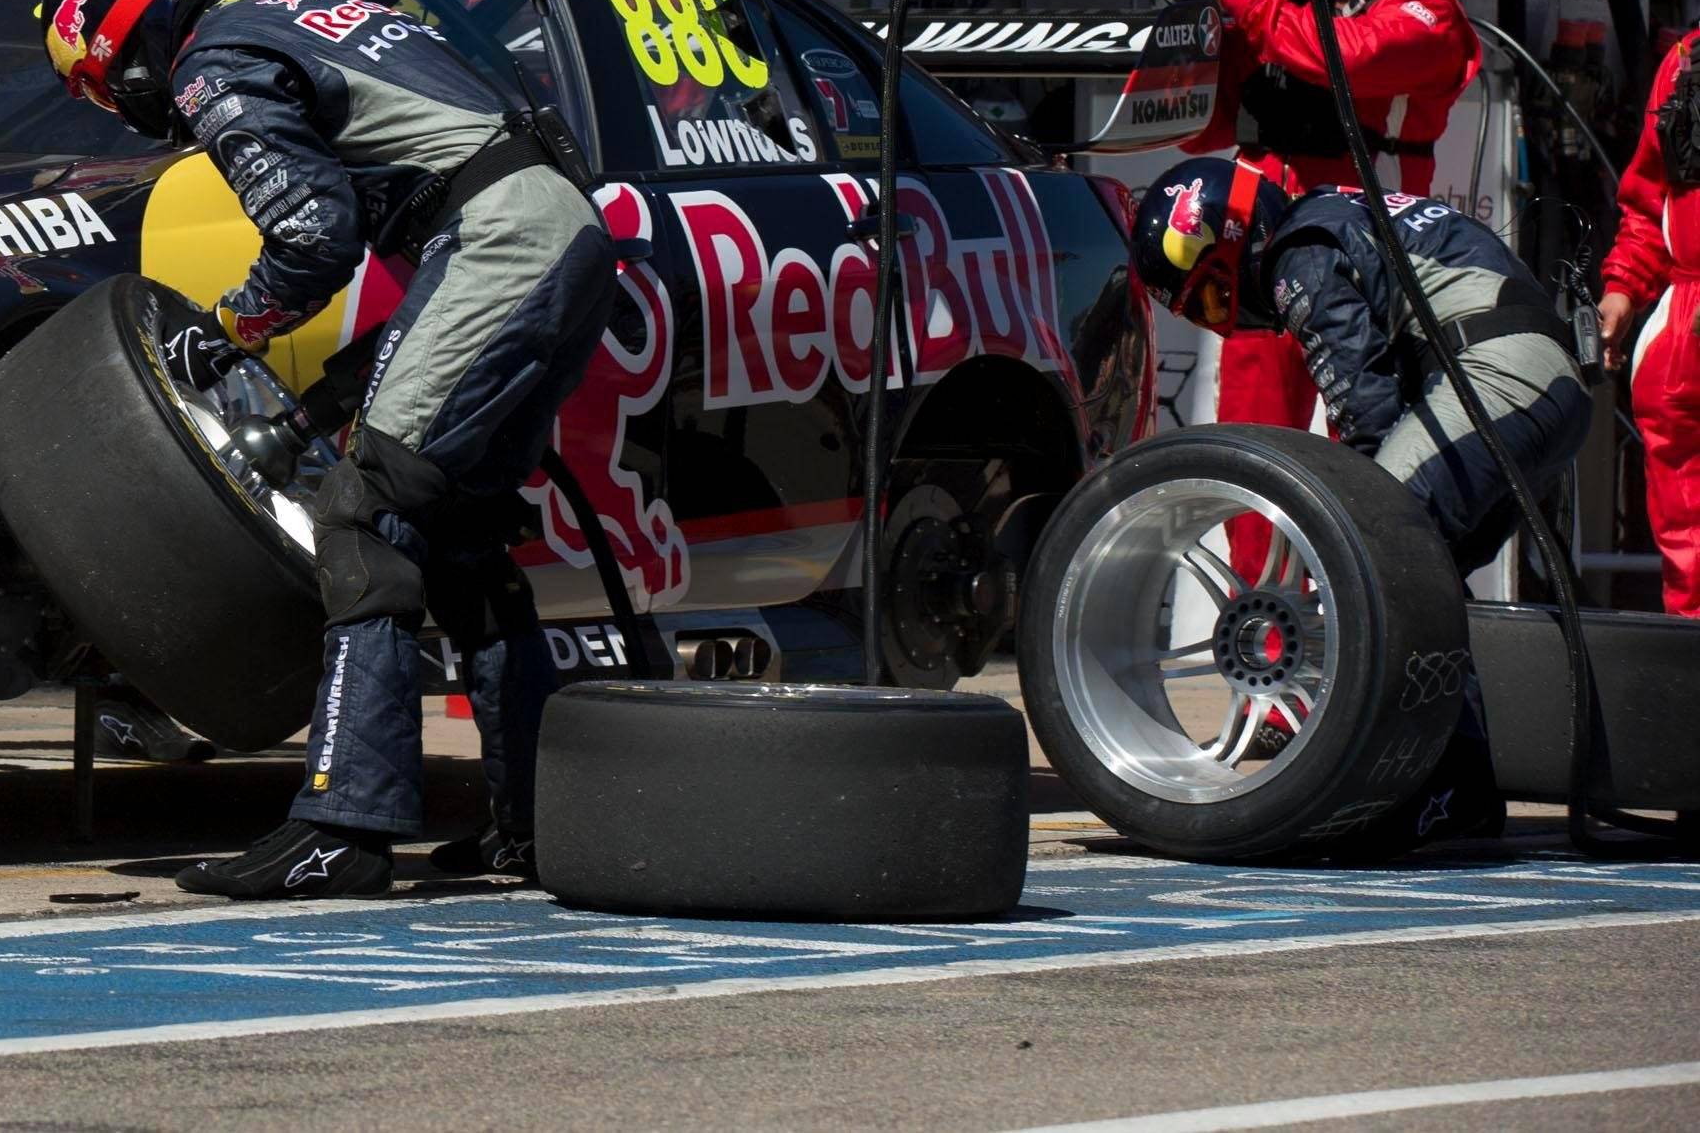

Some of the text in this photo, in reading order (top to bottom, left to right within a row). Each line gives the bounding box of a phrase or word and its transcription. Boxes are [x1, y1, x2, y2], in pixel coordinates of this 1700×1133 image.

[1156, 24, 1197, 49] CALTEX
[647, 105, 817, 166] Lownds
[1132, 89, 1210, 125] KOMATSU
[669, 167, 1063, 411] Red Bull
[363, 329, 402, 410] WINGS
[318, 636, 350, 772] GEARWRENCH
[1400, 648, 1471, 712] 888
